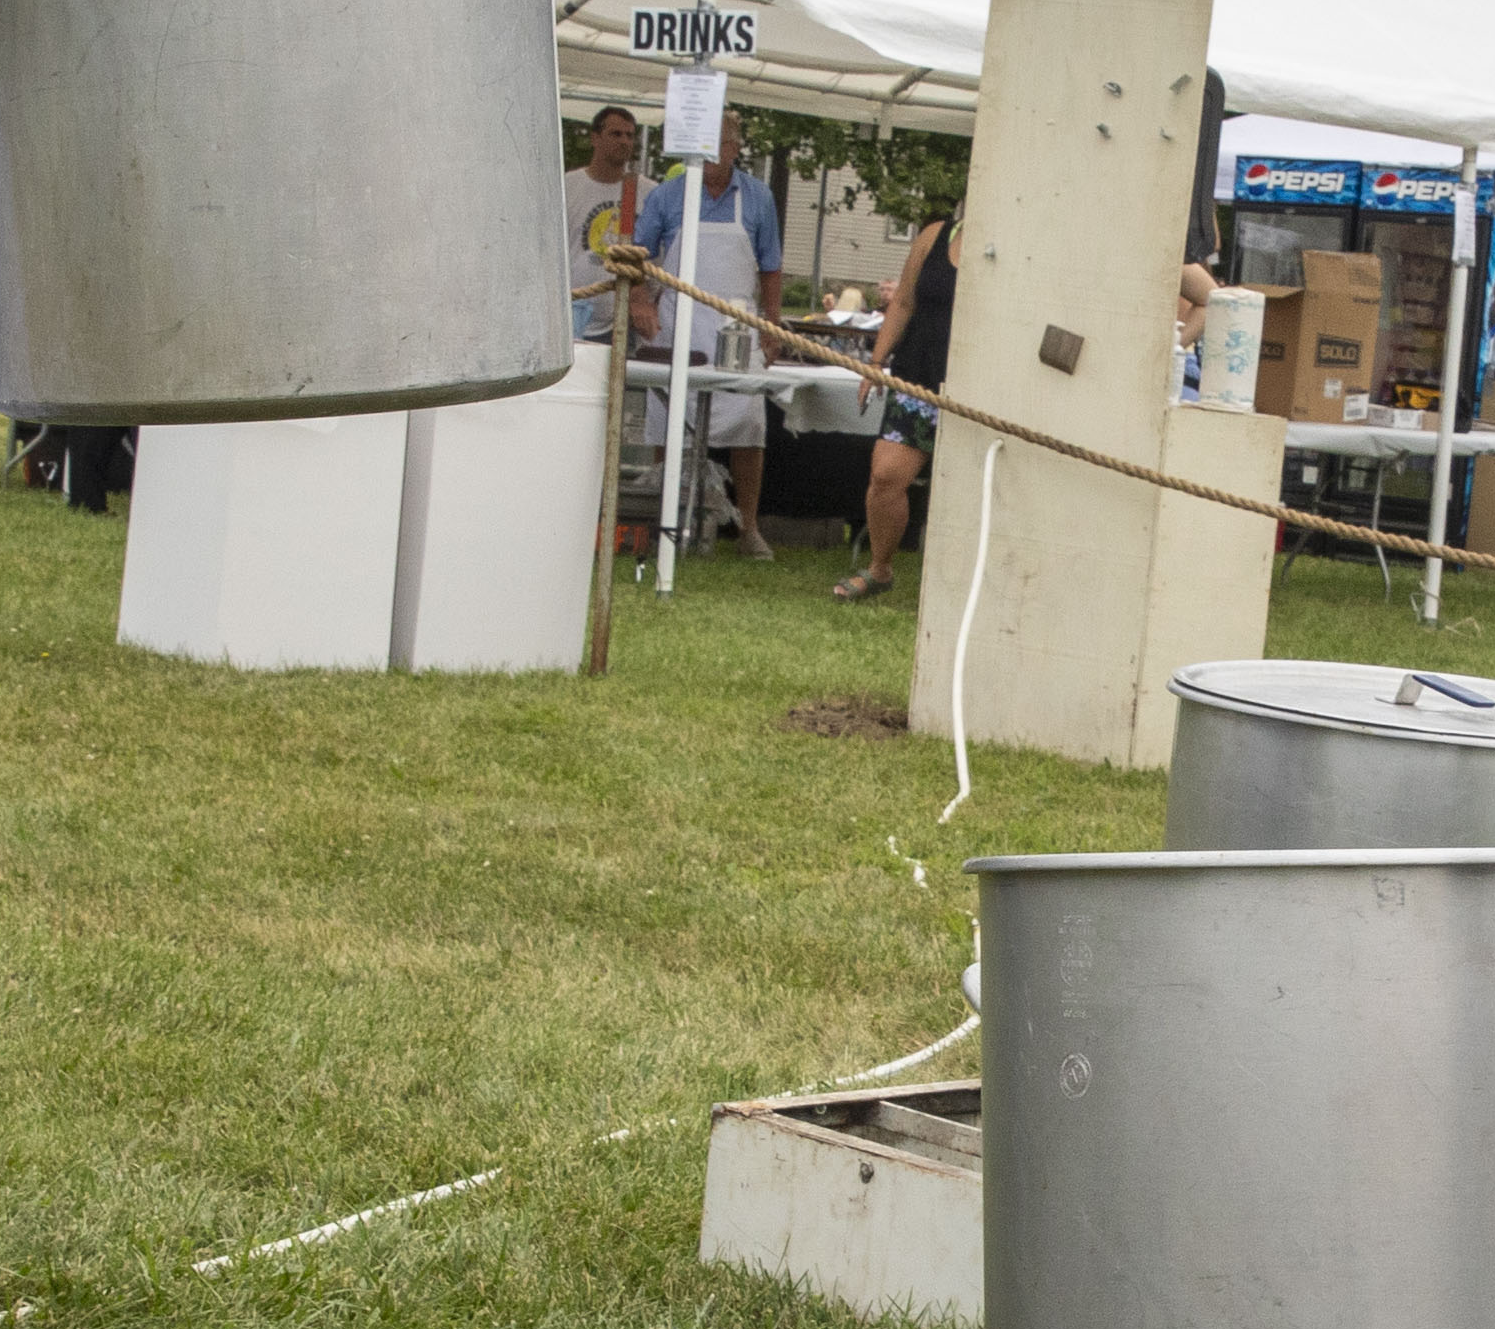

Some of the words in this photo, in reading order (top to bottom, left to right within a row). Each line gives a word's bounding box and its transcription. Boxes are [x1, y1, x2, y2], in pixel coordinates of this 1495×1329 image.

[634, 11, 754, 53] DRINKS
[1267, 170, 1345, 193] PEPSI
[1319, 344, 1358, 361] SOLO
